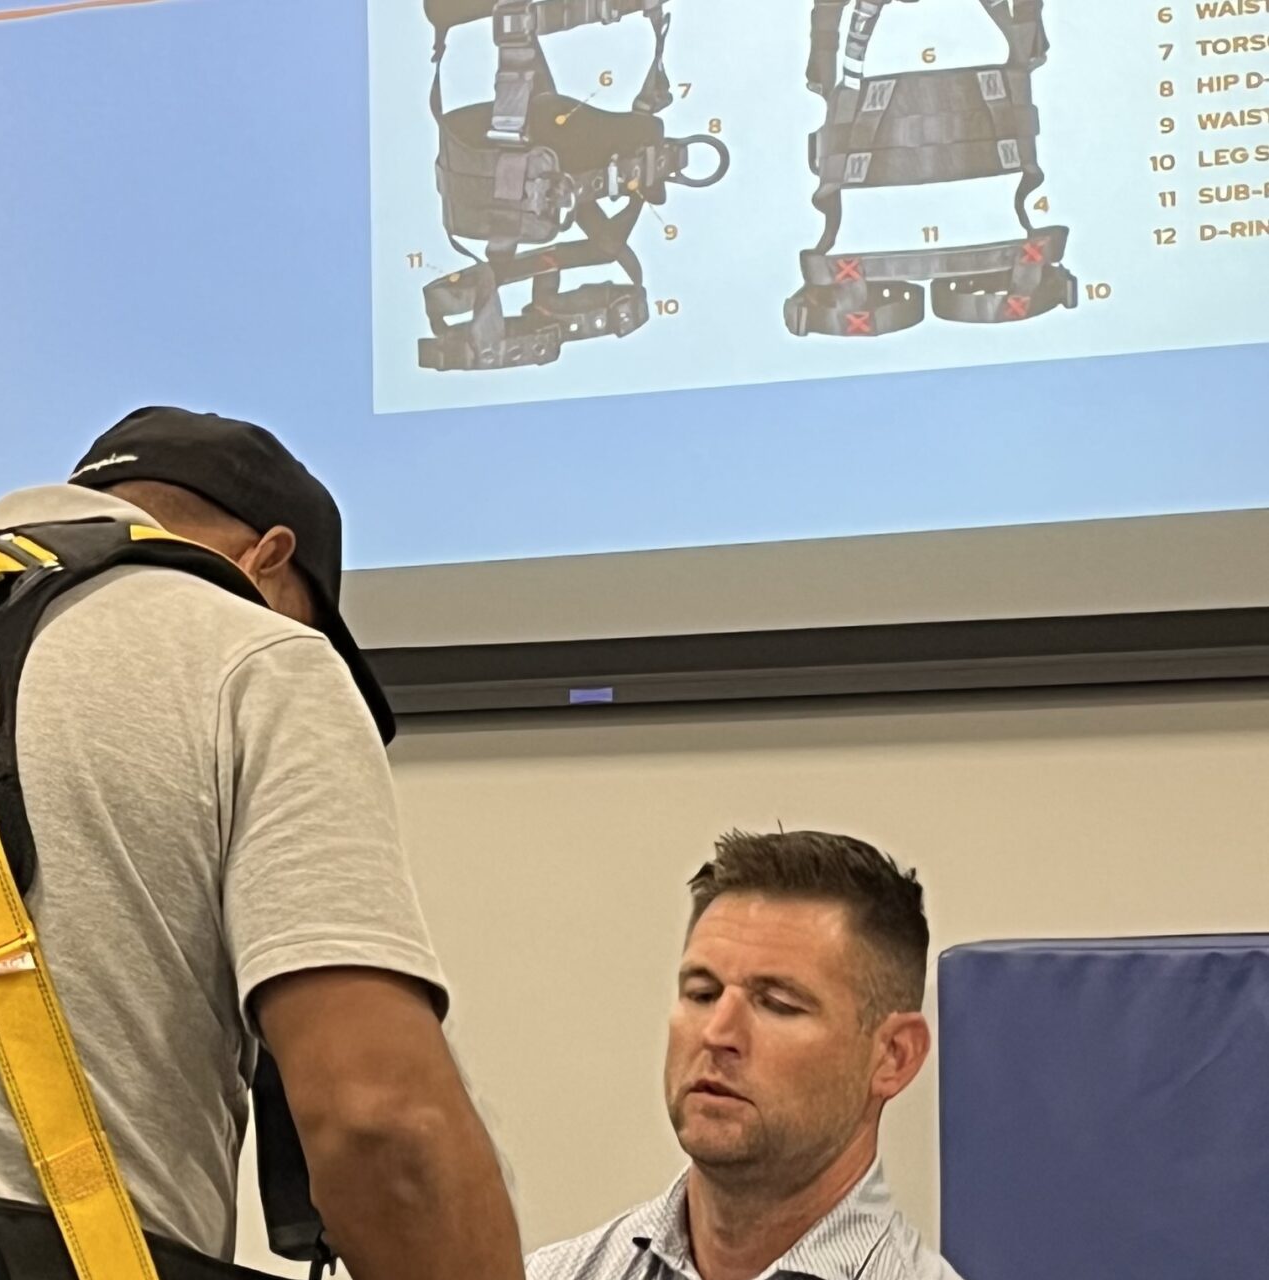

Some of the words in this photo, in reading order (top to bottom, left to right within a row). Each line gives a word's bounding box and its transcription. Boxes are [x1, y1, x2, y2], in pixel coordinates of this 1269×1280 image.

[1157, 7, 1173, 24] 6
[921, 48, 936, 63] 6
[1158, 43, 1174, 61] 7
[1195, 34, 1269, 56] TORS
[599, 71, 613, 87] 6
[1159, 80, 1174, 97] 8
[1197, 74, 1240, 94] HIP
[677, 82, 692, 99] 7
[708, 118, 722, 134] 8
[1160, 117, 1175, 134] 9
[1149, 154, 1176, 172] 10
[1198, 147, 1249, 168] LEG
[1033, 196, 1050, 213] 4
[1158, 191, 1176, 207] 11
[663, 225, 678, 240] 9
[921, 226, 939, 243] 11
[1153, 227, 1177, 245] 12
[406, 252, 423, 268] 11
[1085, 283, 1112, 300] 10
[654, 299, 680, 315] 10
